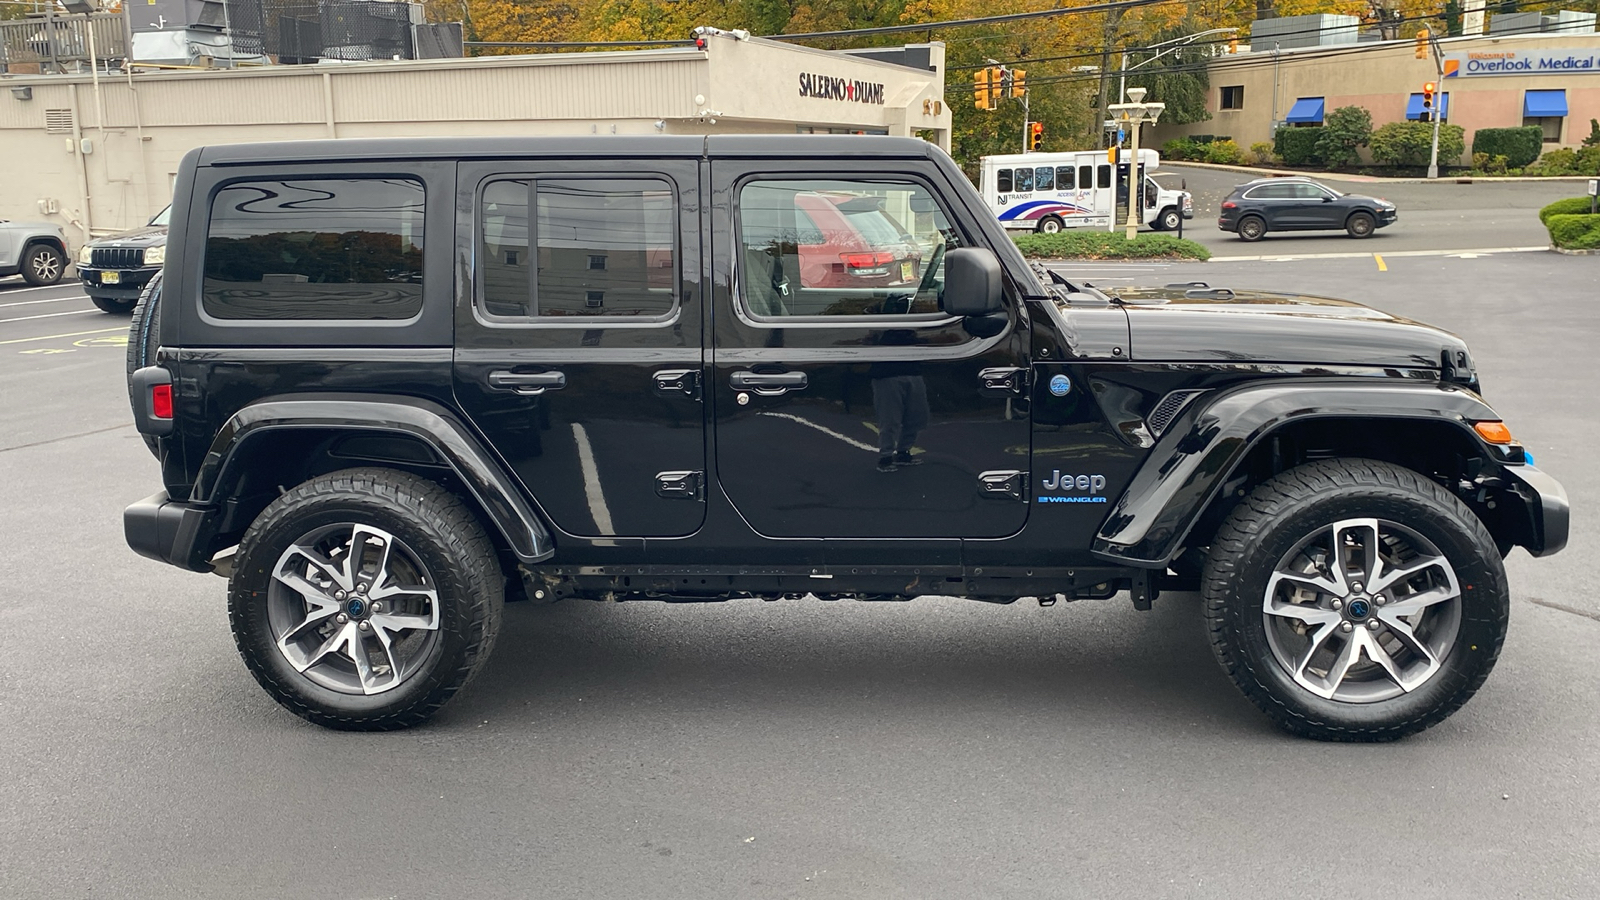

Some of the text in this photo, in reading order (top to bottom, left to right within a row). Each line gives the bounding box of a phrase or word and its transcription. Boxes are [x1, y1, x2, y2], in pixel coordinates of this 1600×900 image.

[1467, 57, 1532, 72] Overlook
[1538, 56, 1594, 70] Medical
[799, 72, 885, 105] SALERNO DUANE
[1042, 469, 1106, 495] Jeep
